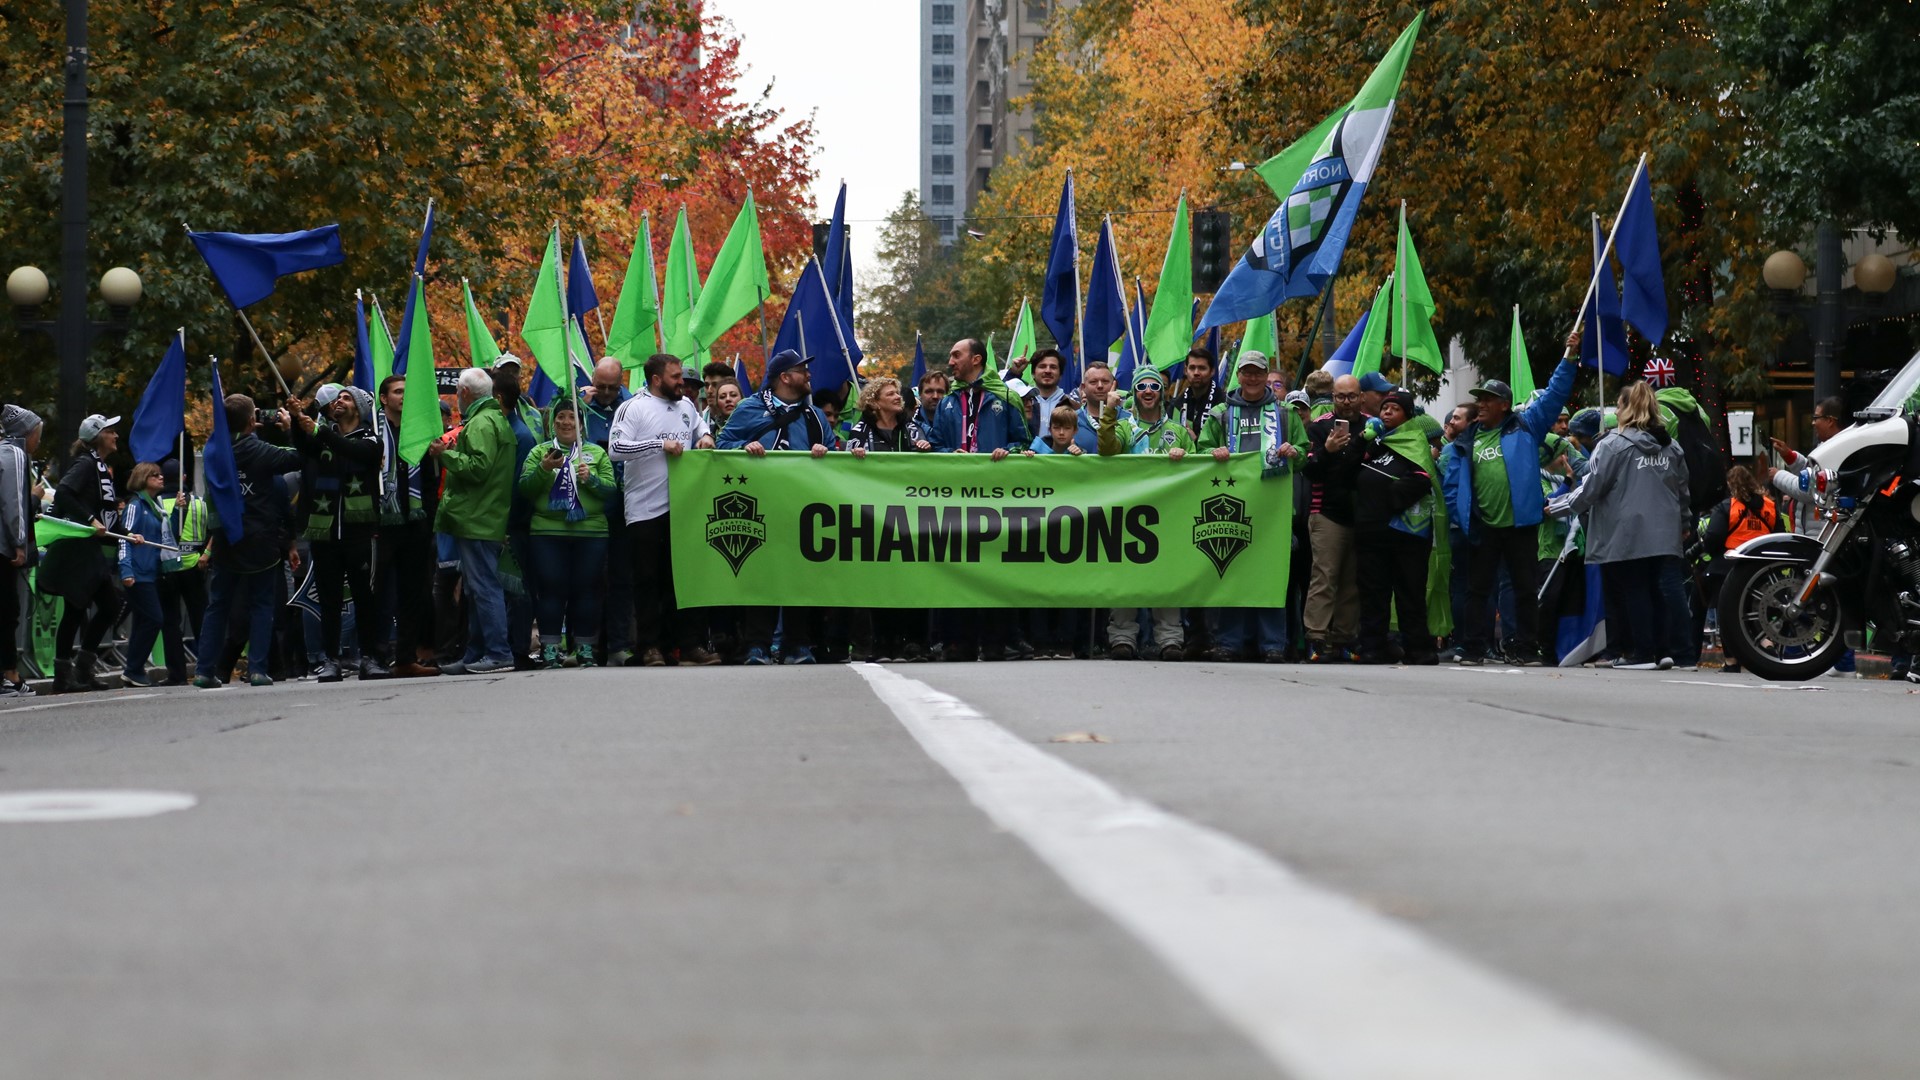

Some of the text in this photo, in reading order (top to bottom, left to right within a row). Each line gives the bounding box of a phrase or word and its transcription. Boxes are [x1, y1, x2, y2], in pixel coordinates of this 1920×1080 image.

[905, 486, 1055, 499] 2019 MLS CUP
[708, 524, 763, 538] SOUNDERS FC
[1195, 527, 1250, 540] SOUNDERS FC
